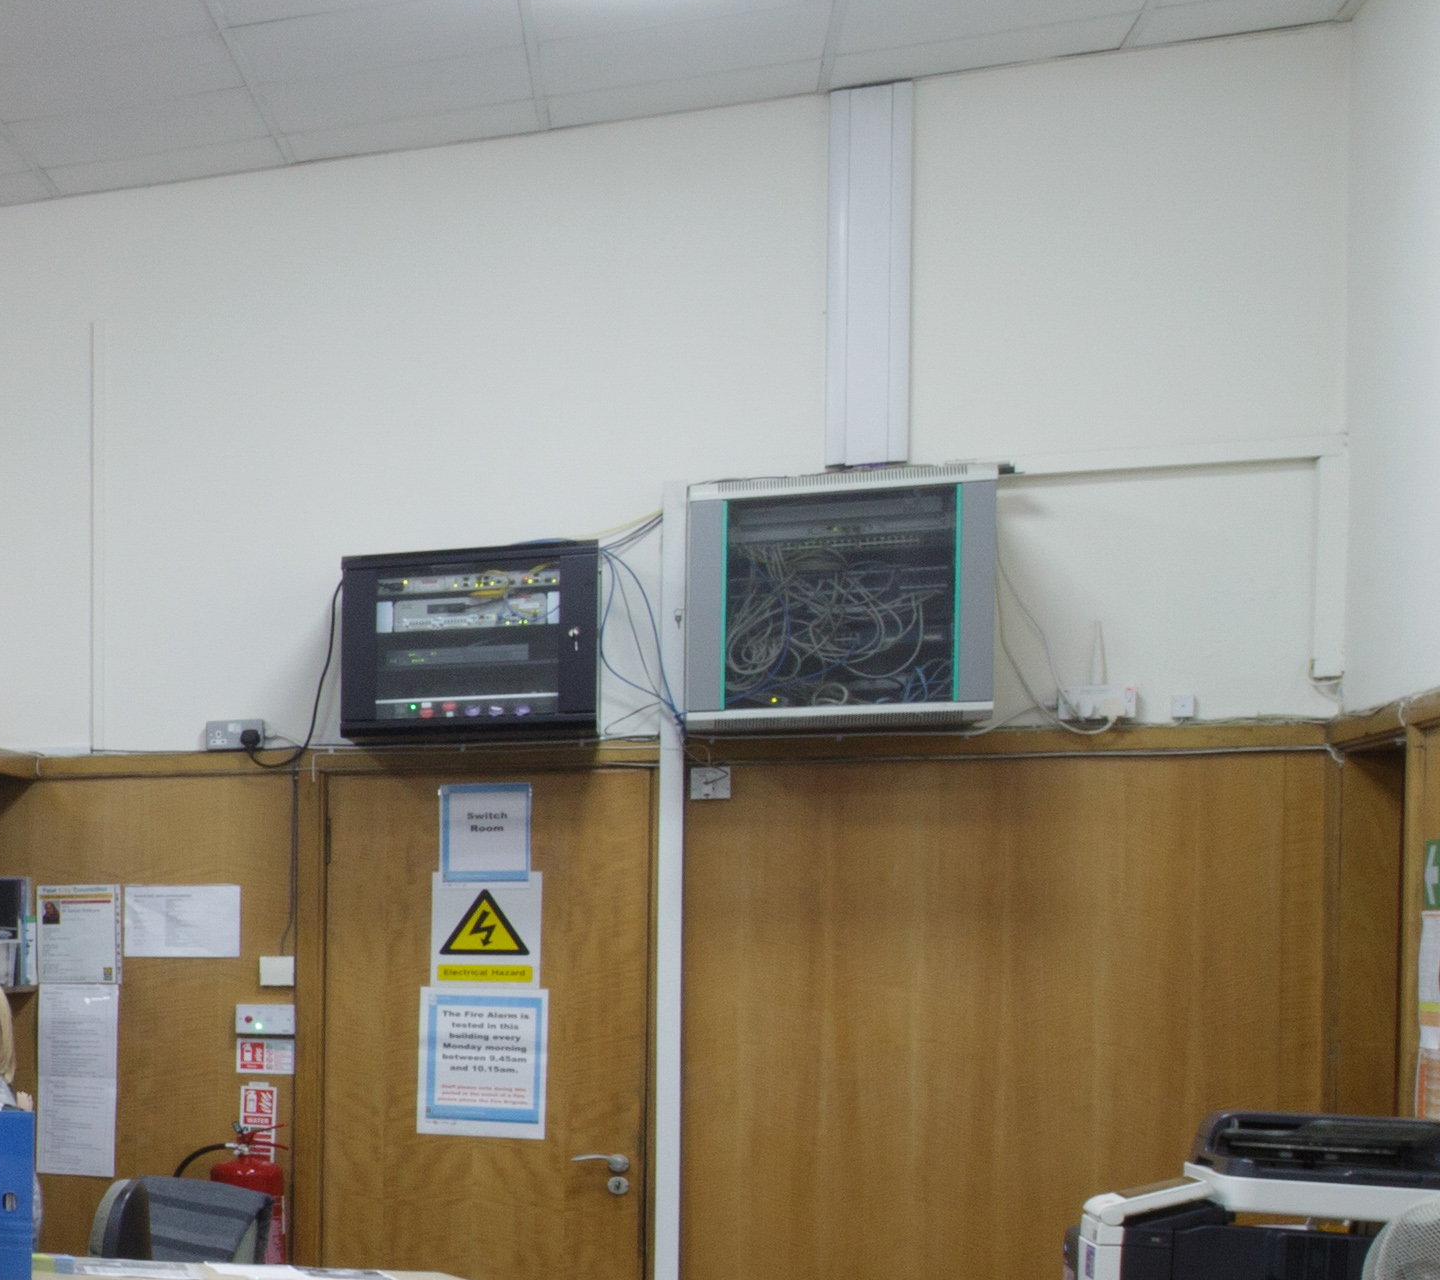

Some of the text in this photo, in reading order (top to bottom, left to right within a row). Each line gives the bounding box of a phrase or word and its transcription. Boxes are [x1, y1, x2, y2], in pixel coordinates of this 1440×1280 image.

[466, 811, 508, 820] Switch
[470, 824, 504, 833] Room
[443, 968, 526, 977] Electrical Hazard
[464, 1010, 484, 1018] Fire
[487, 1011, 517, 1019] Alarm
[451, 1021, 484, 1029] tested
[499, 1022, 519, 1030] this
[449, 1033, 489, 1041] building
[442, 1042, 527, 1053] Monday morning
[442, 1053, 527, 1063] between 9.45am
